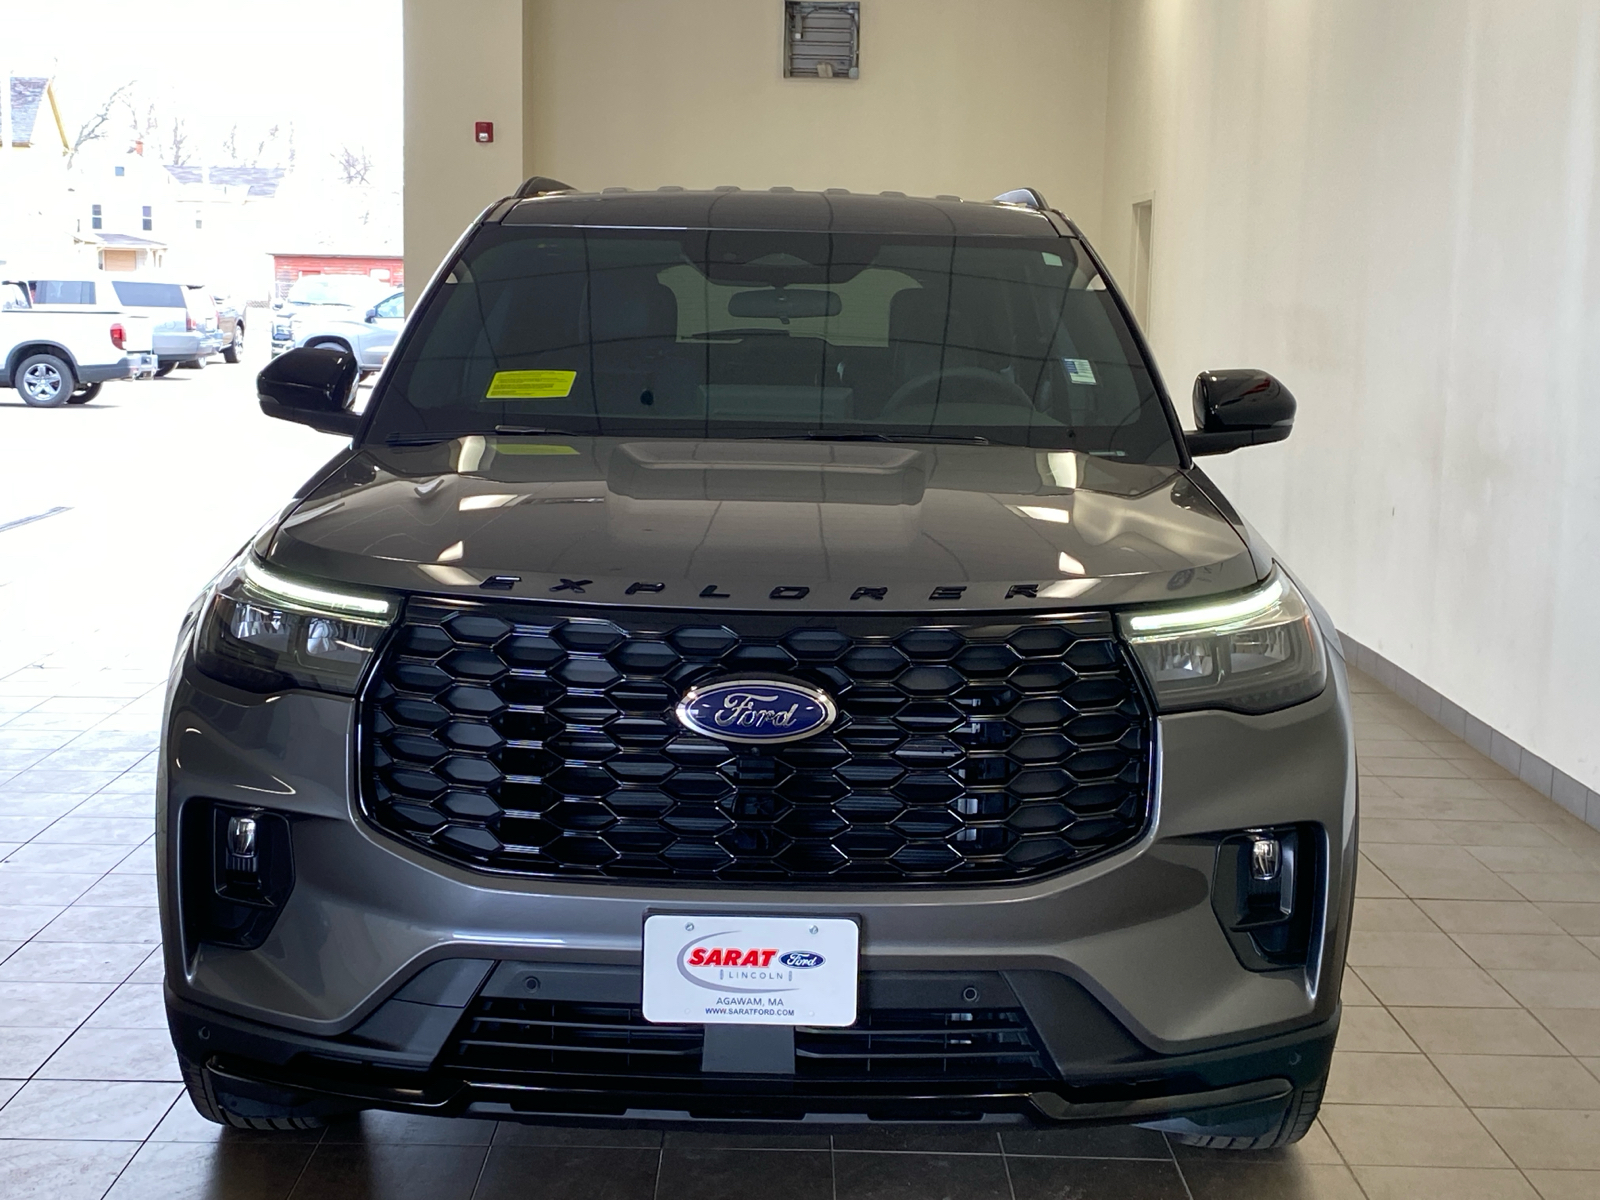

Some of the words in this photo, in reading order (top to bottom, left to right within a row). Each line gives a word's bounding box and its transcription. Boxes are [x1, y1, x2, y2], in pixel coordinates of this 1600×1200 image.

[479, 574, 1039, 600] EXPLORER
[714, 692, 798, 728] Ford
[687, 947, 778, 967] SARAT
[787, 953, 816, 967] Ford
[728, 971, 783, 979] LINCOLN
[716, 997, 765, 1007] AGAWAM,
[768, 998, 784, 1006] MA
[705, 1007, 795, 1016] WWW.SARATFORD.COM
